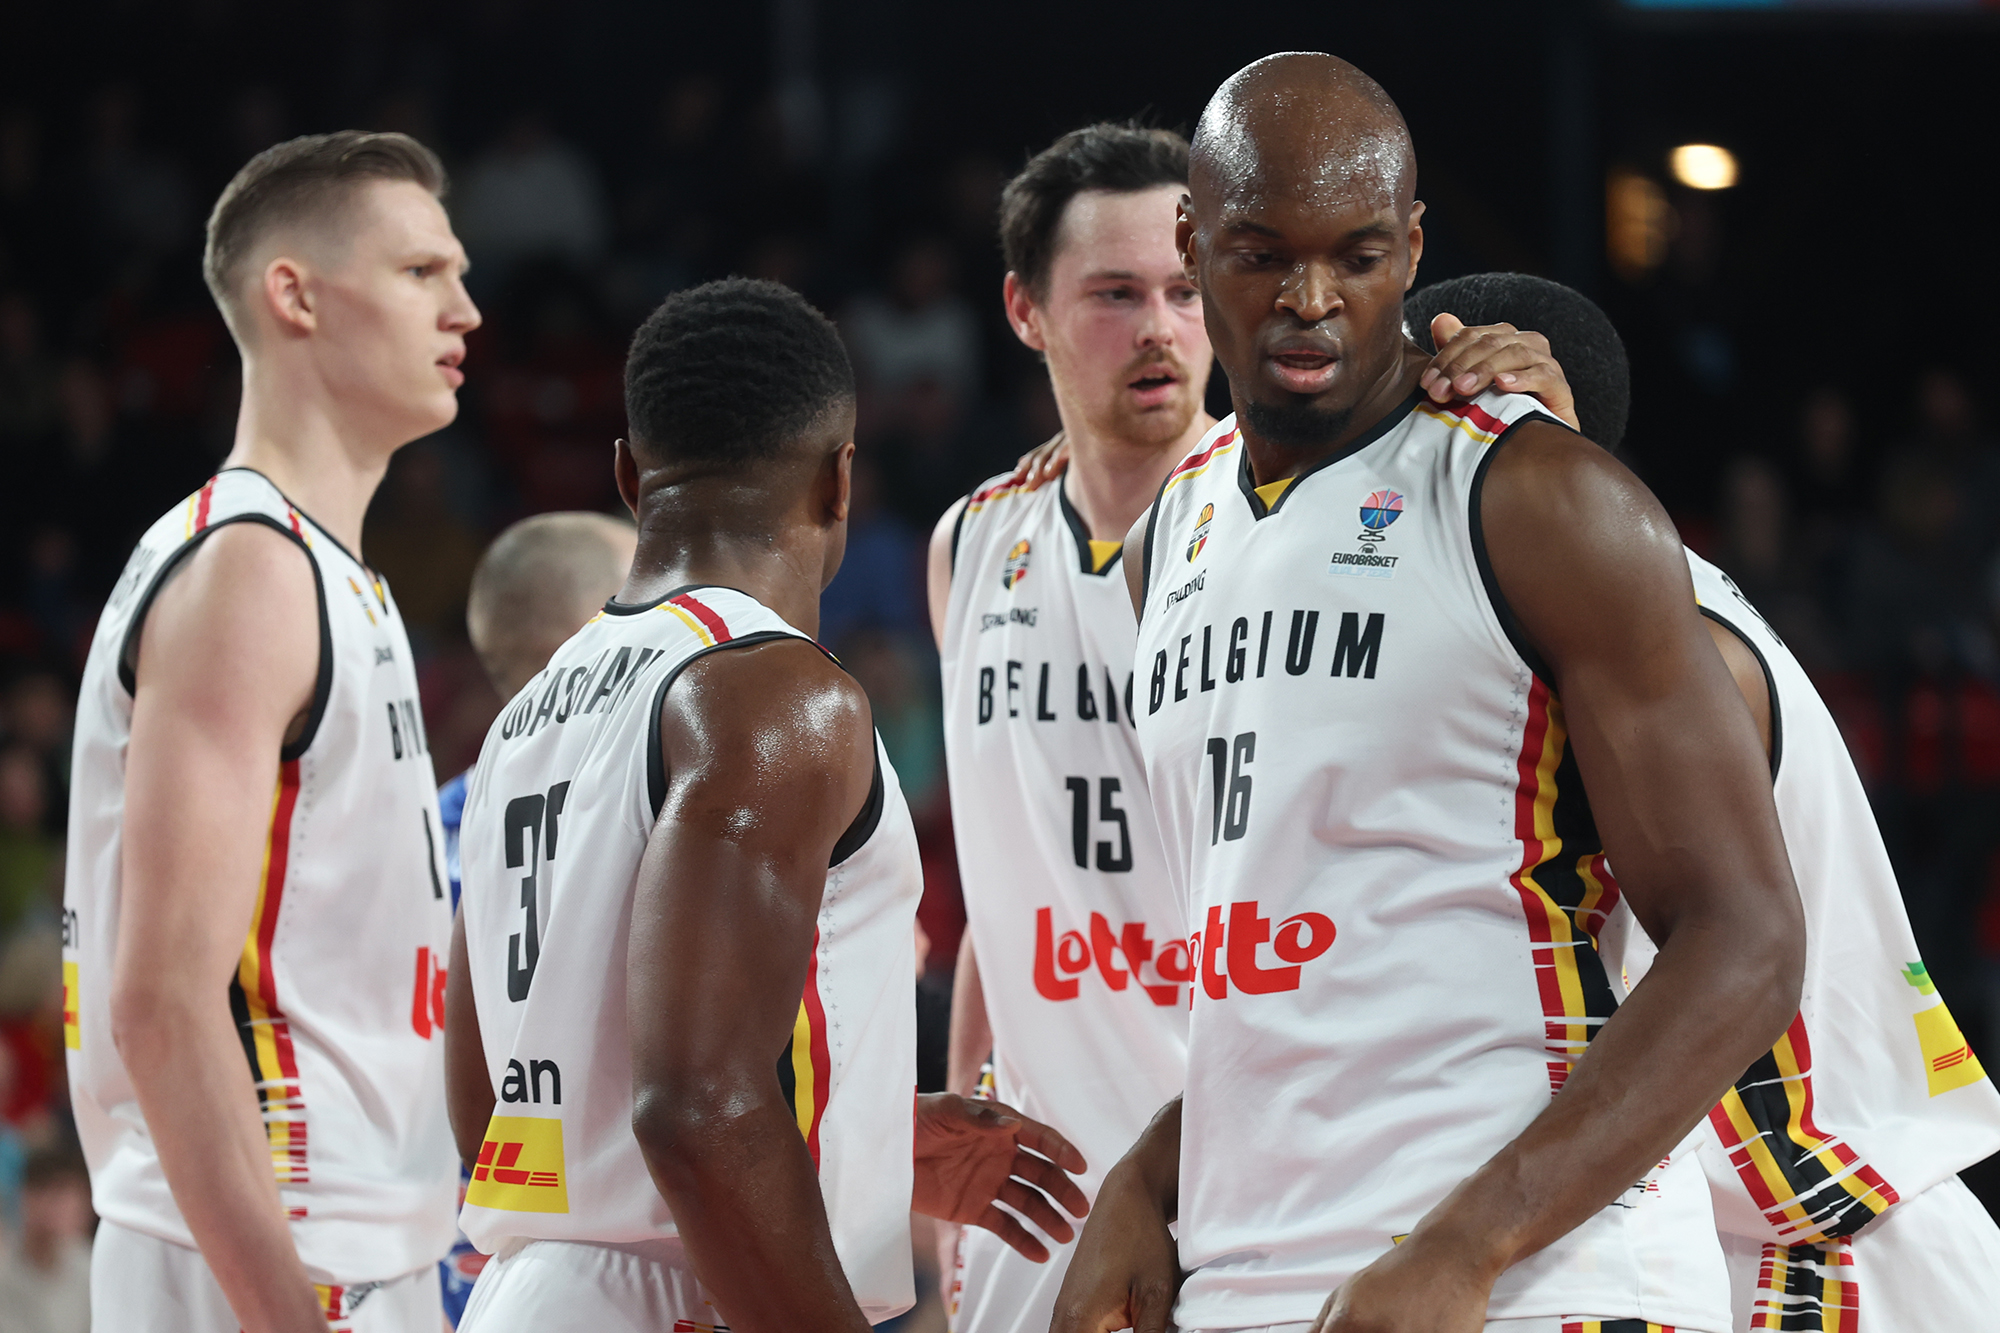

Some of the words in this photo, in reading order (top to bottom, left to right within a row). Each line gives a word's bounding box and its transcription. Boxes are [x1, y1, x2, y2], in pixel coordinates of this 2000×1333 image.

[1331, 552, 1399, 568] EUROBASKET
[979, 660, 1137, 730] BELGI
[1148, 609, 1385, 716] BELGIUM
[1066, 776, 1133, 873] 15
[1207, 731, 1256, 846] 16
